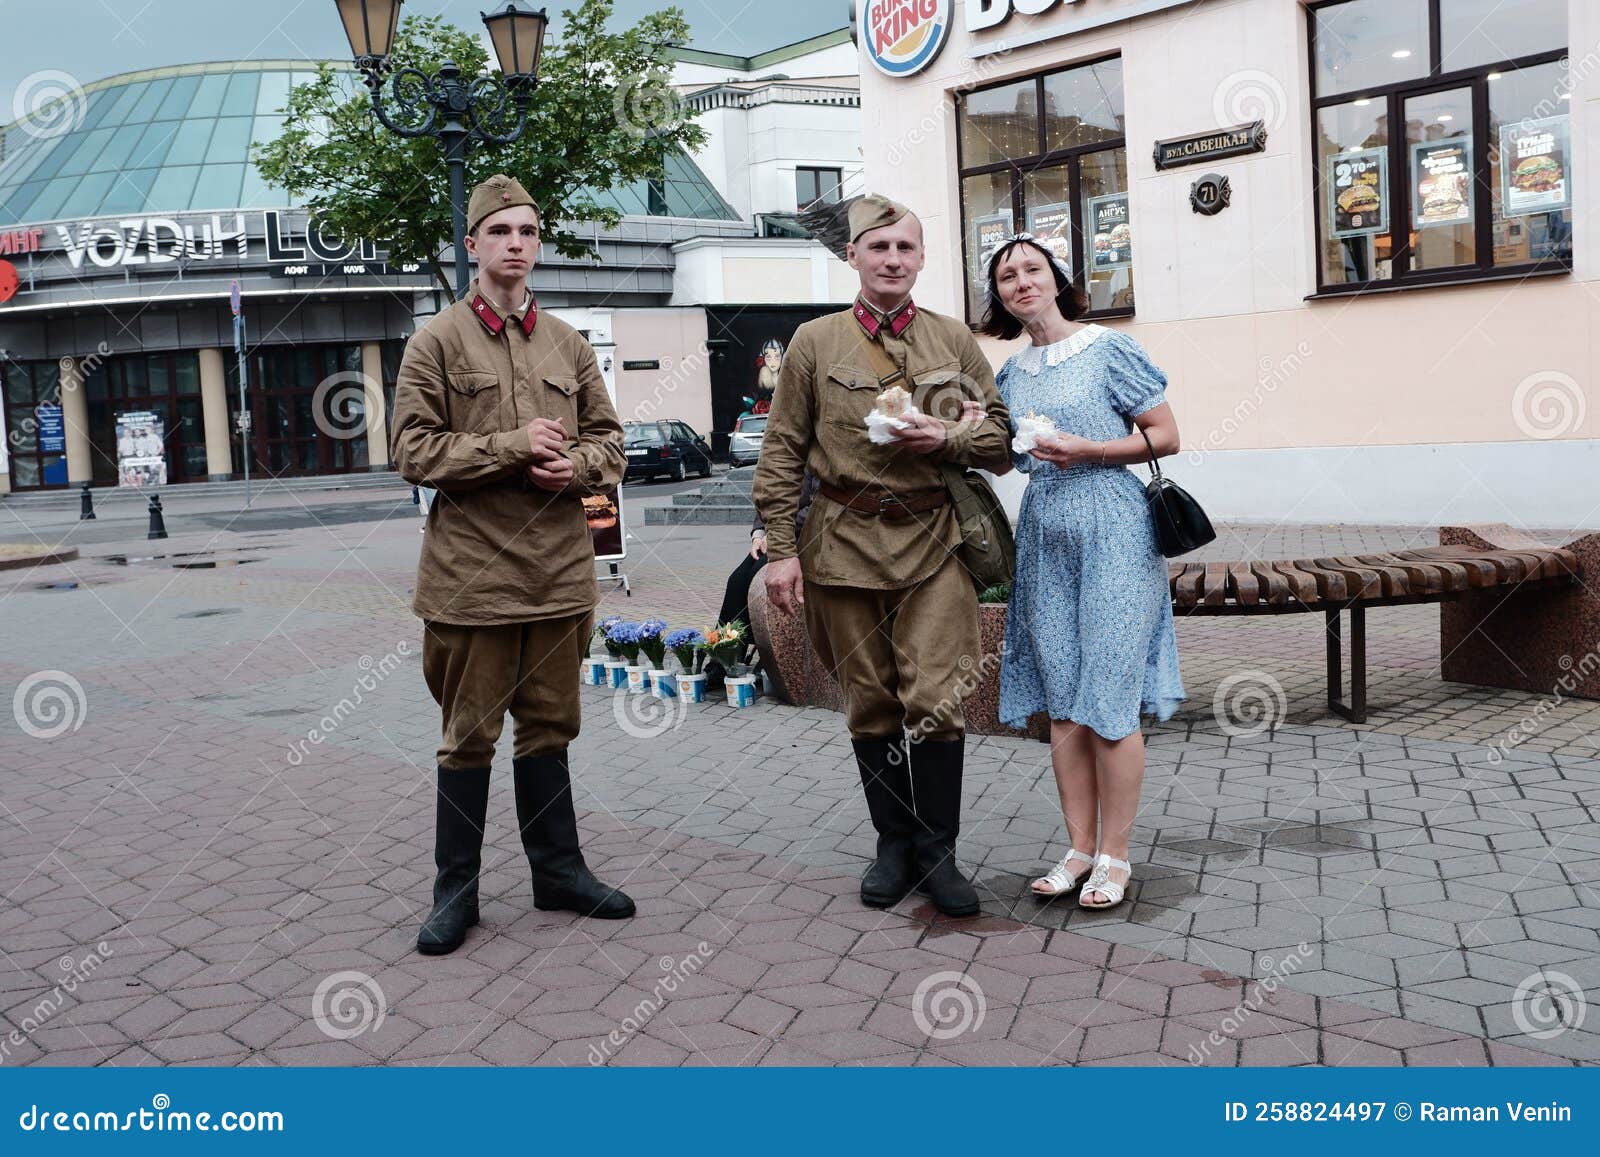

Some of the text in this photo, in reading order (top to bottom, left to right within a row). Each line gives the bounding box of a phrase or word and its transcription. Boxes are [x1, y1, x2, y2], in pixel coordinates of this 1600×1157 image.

[875, 0, 937, 56] KING
[1185, 132, 1248, 155] САВЕЦКАЯ
[1201, 186, 1214, 202] 71
[1098, 206, 1126, 218] АНГУС
[284, 264, 420, 275] ЛОФТ КЛУБ БАР
